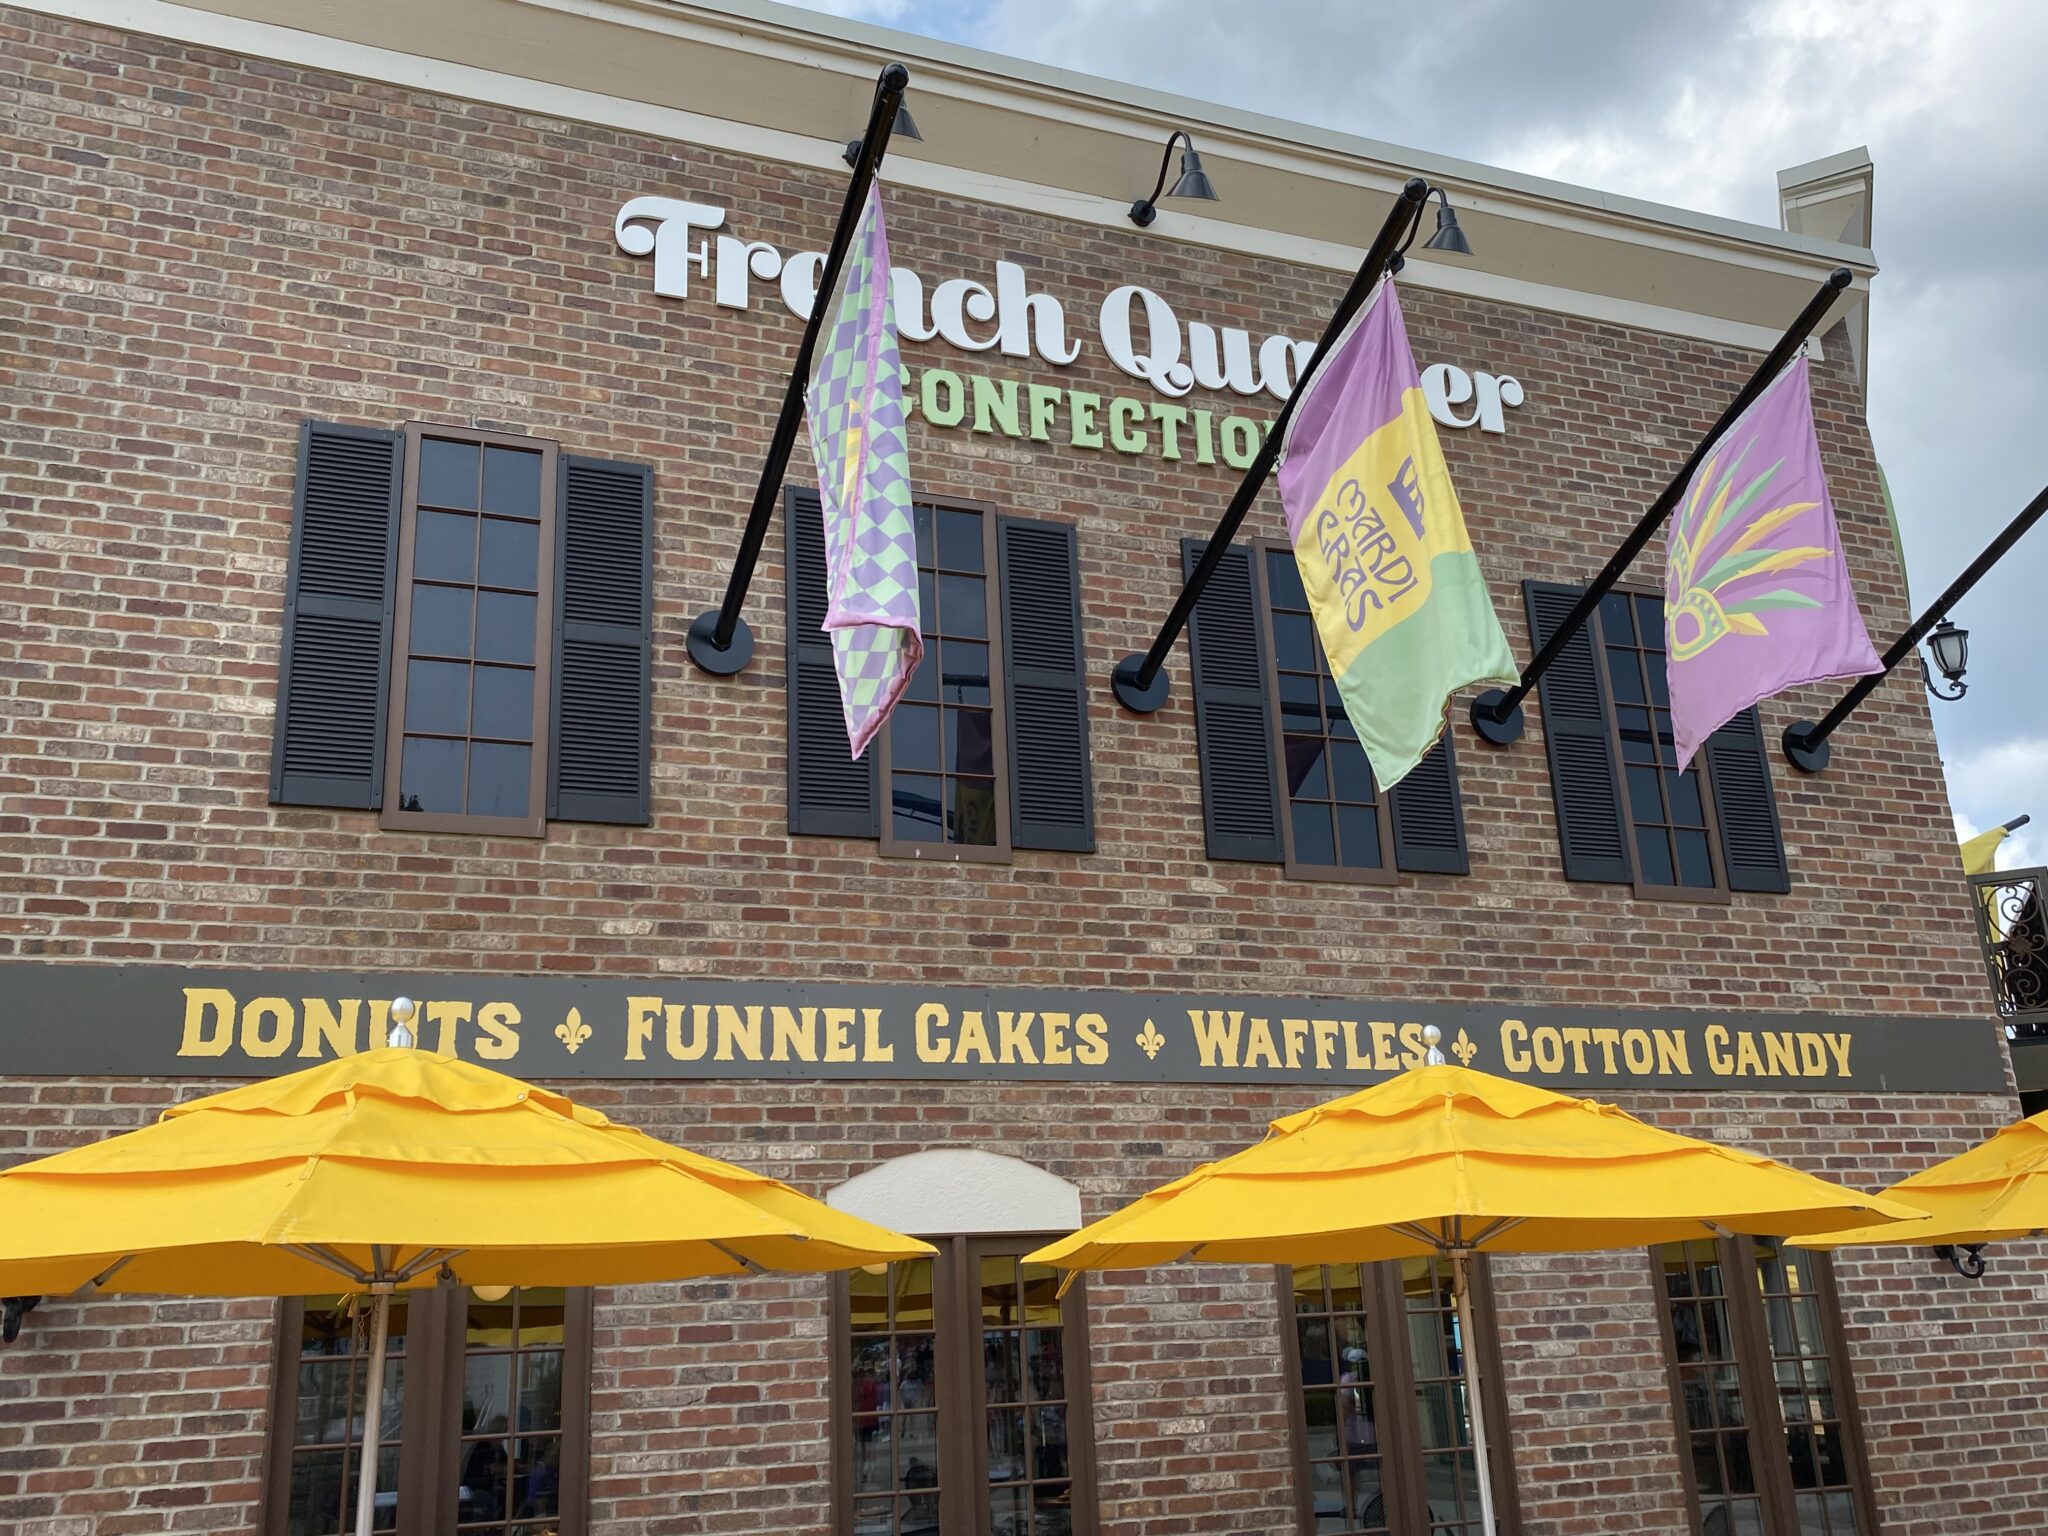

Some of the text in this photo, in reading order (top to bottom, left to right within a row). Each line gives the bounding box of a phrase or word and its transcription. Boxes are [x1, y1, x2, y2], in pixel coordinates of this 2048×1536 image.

[1099, 285, 1525, 434] Quaer
[900, 363, 1278, 475] ONFECTIO
[1317, 510, 1383, 632] GRAS
[177, 988, 521, 1060] DONUTS
[624, 996, 1109, 1065] FUNNEL CAKES
[1187, 1010, 1425, 1070] WAFFLES
[1500, 1019, 1852, 1077] COTTON CANDY
